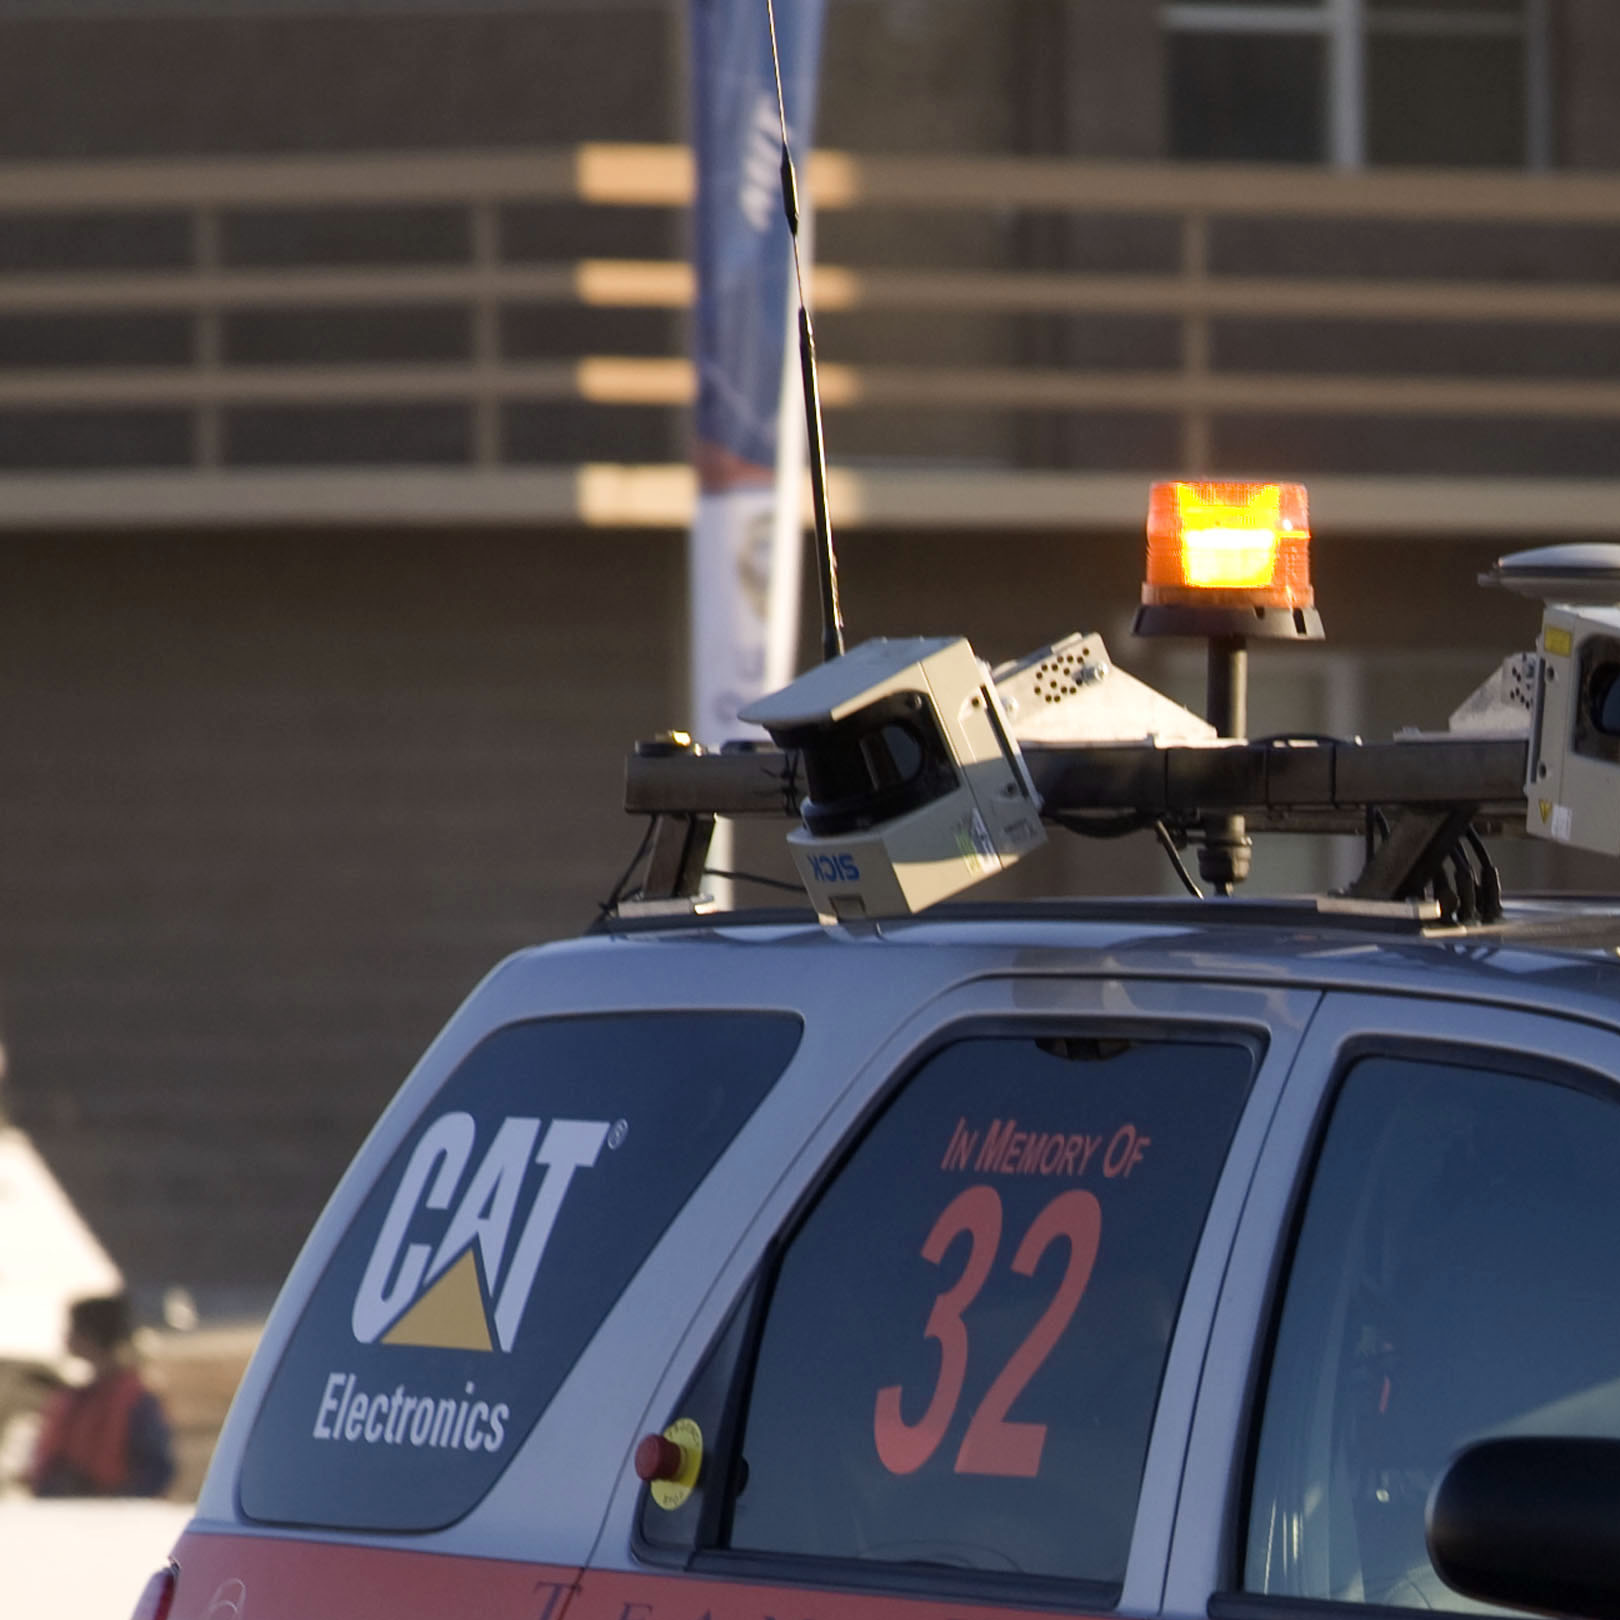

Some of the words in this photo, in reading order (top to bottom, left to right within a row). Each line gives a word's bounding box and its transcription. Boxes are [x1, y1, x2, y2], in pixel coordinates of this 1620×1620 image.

[807, 852, 861, 884] SICK
[941, 1117, 979, 1171] IN
[974, 1119, 1103, 1177] MEMORY
[1103, 1123, 1150, 1179] OF
[873, 1184, 1103, 1479] 32
[313, 1372, 510, 1453] Electronics
